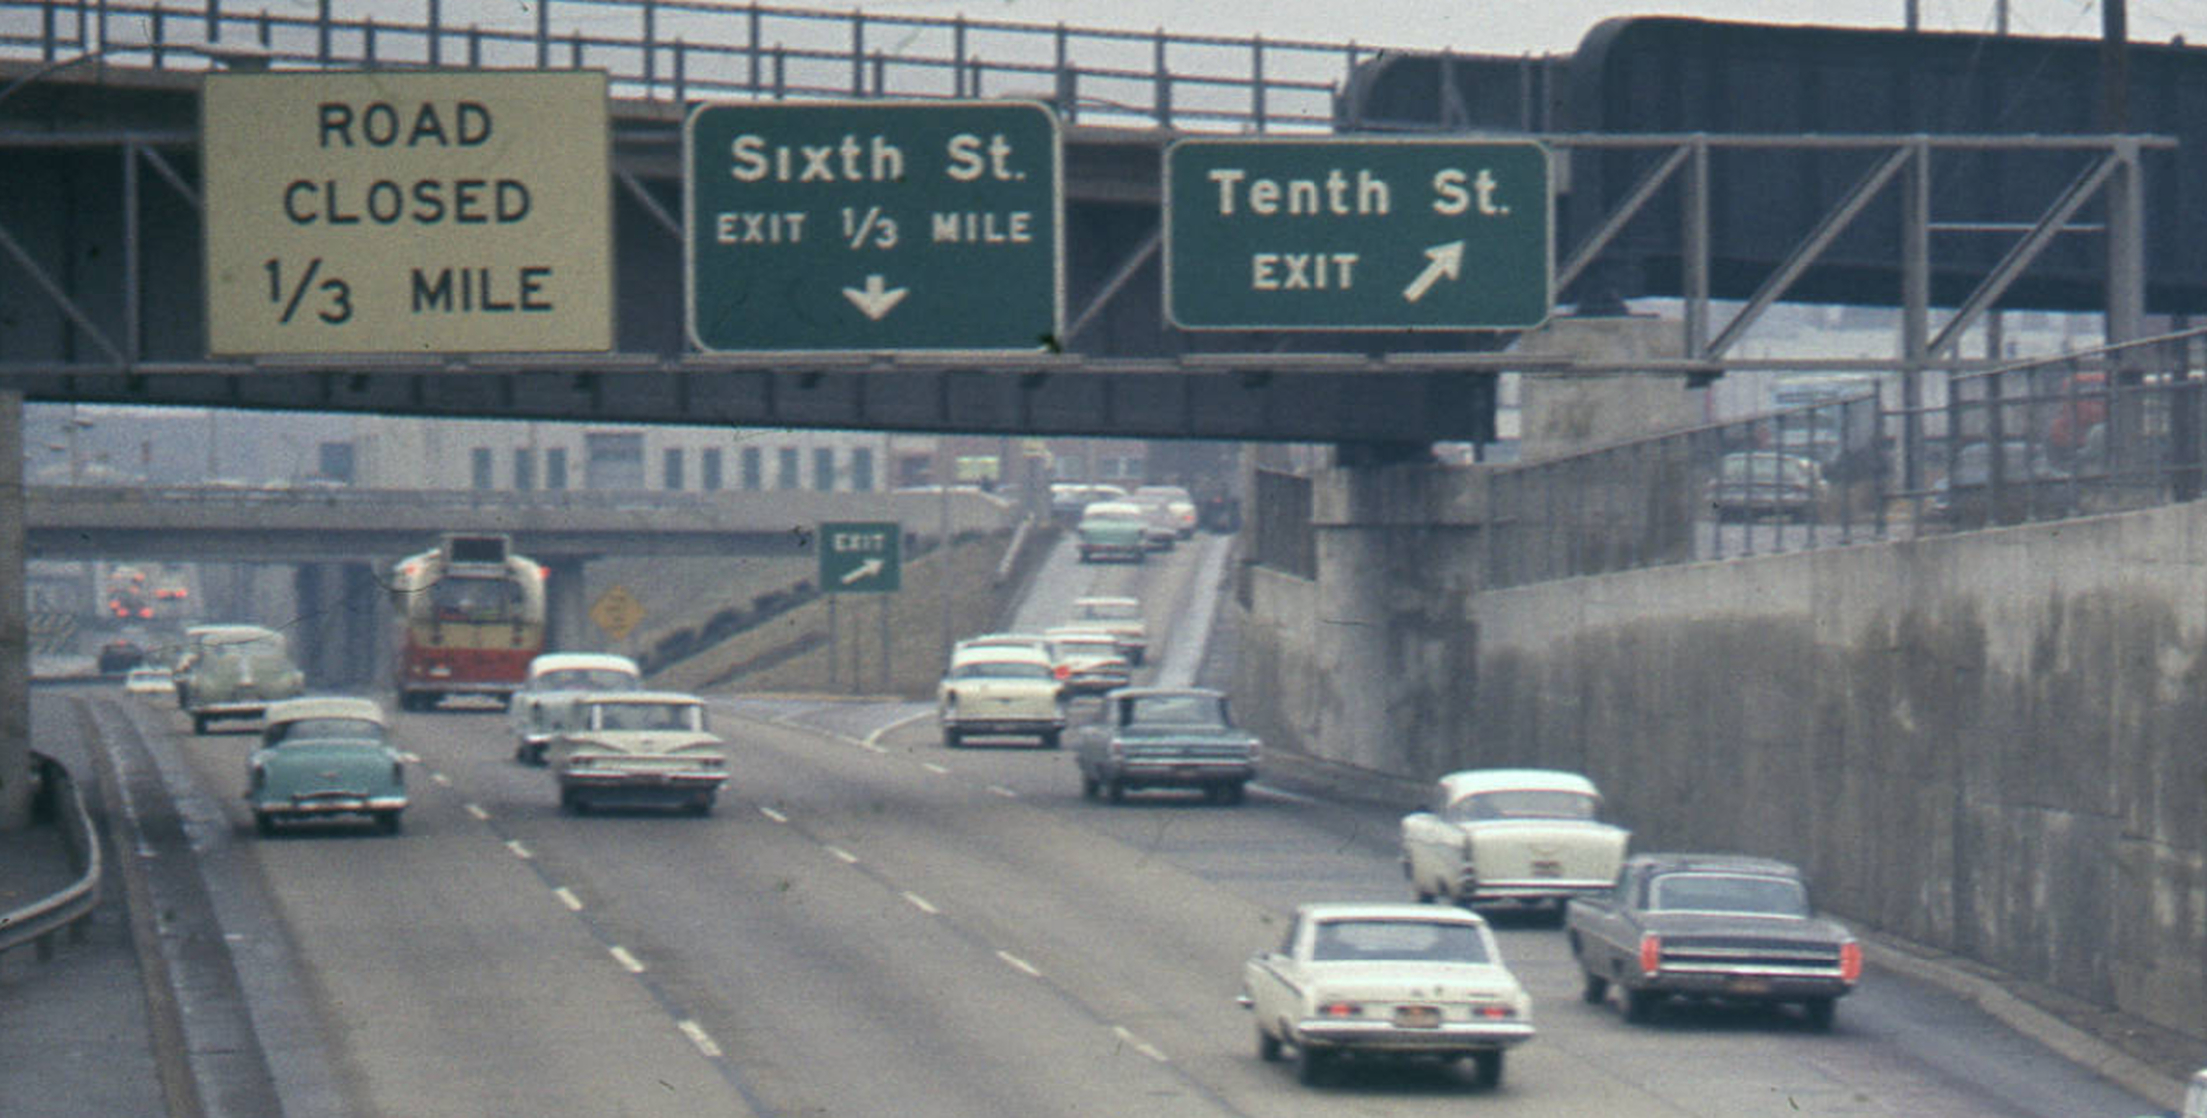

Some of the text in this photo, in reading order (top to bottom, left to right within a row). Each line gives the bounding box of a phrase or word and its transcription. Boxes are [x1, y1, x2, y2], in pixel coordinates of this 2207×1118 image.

[319, 102, 492, 147] ROAD
[731, 133, 1026, 182] Sixth St.
[283, 179, 531, 225] CLOSED
[1208, 168, 1511, 215] Tenth St.
[716, 206, 1033, 250] EXIT 1/3 MILE
[264, 257, 554, 325] 1/3 MILE
[1252, 253, 1359, 290] EXIT
[834, 533, 884, 551] EXIT
